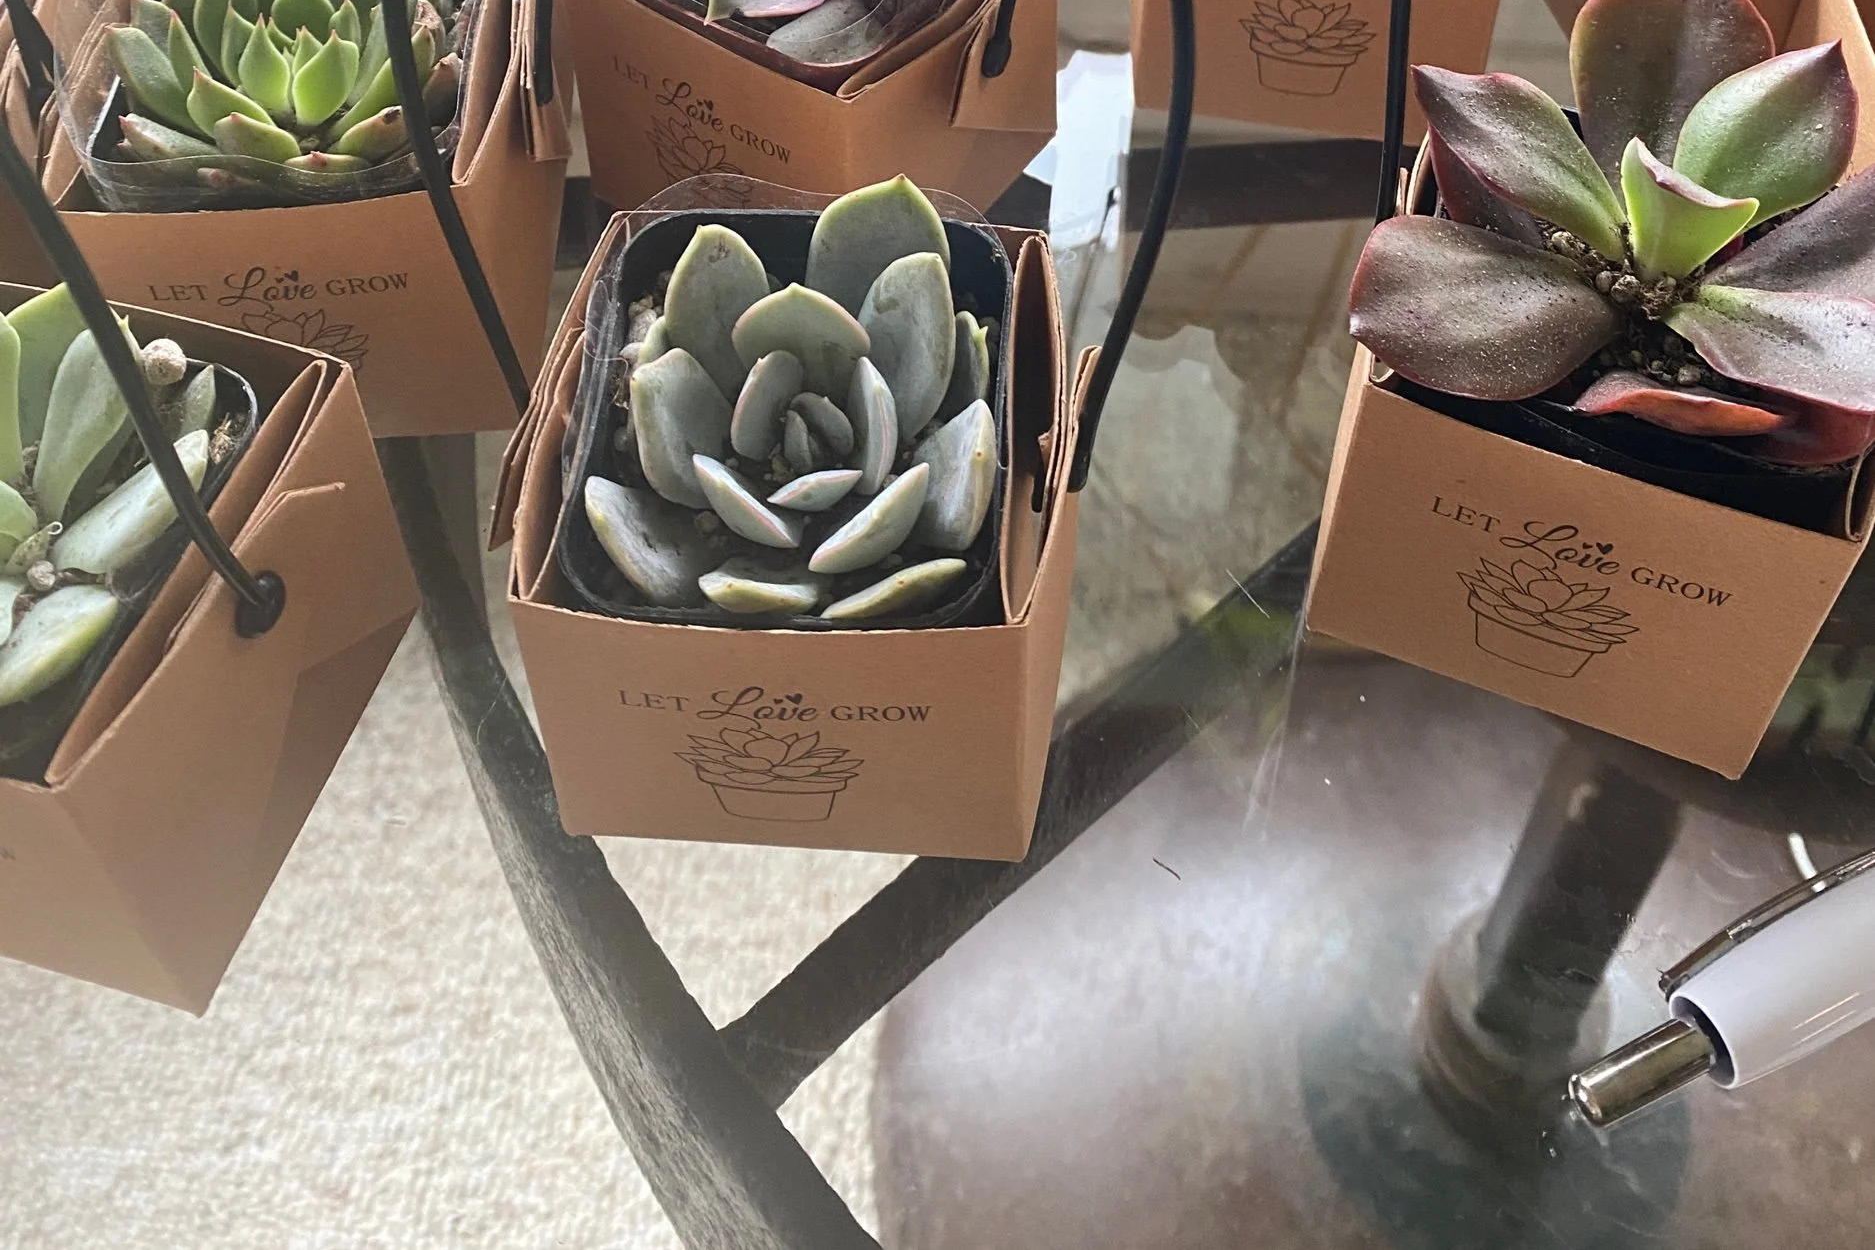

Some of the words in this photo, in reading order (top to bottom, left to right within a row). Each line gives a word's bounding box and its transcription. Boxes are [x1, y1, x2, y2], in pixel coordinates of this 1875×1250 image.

[612, 55, 649, 90] LET
[655, 77, 724, 132] Love
[730, 123, 791, 164] GROW
[149, 284, 208, 302] LET
[217, 266, 318, 312] Love
[325, 272, 409, 297] GROW
[1430, 495, 1501, 533] LET
[1499, 520, 1621, 576] Love
[1630, 565, 1735, 608] GROW
[616, 689, 690, 713] LET
[696, 685, 819, 730] Love
[830, 704, 933, 723] GROW
